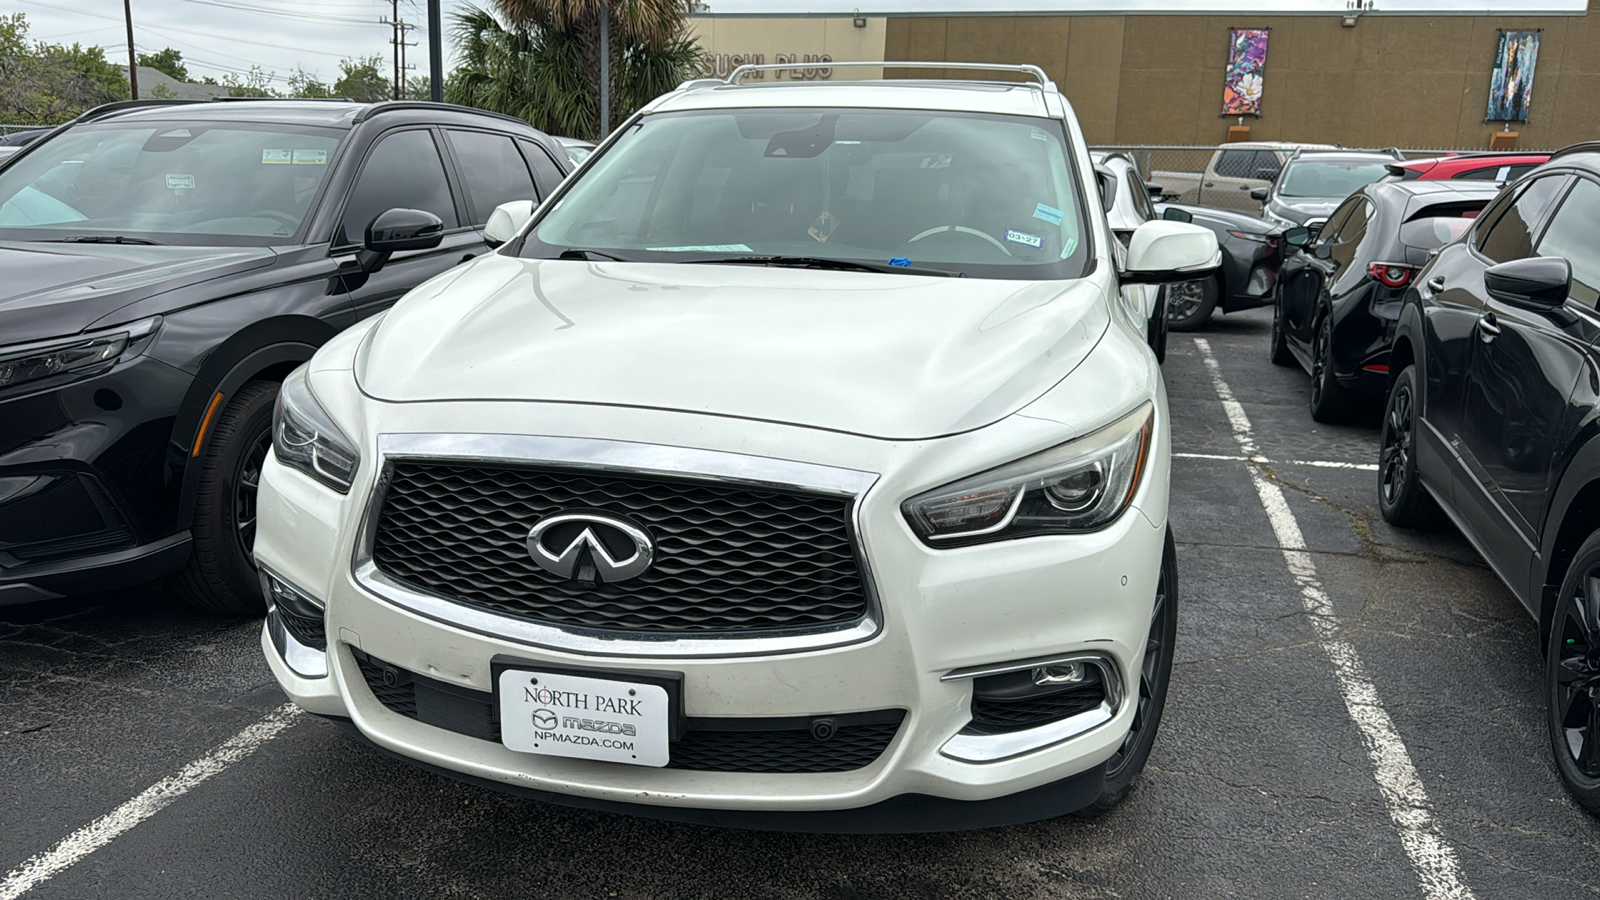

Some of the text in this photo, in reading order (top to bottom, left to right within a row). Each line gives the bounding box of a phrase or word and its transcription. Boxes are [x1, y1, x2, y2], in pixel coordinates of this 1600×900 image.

[703, 53, 833, 79] SUSHI PLUS
[523, 686, 644, 717] NORTH PARK
[562, 716, 637, 737] mazda
[534, 730, 634, 751] NPMAZDA.COM
